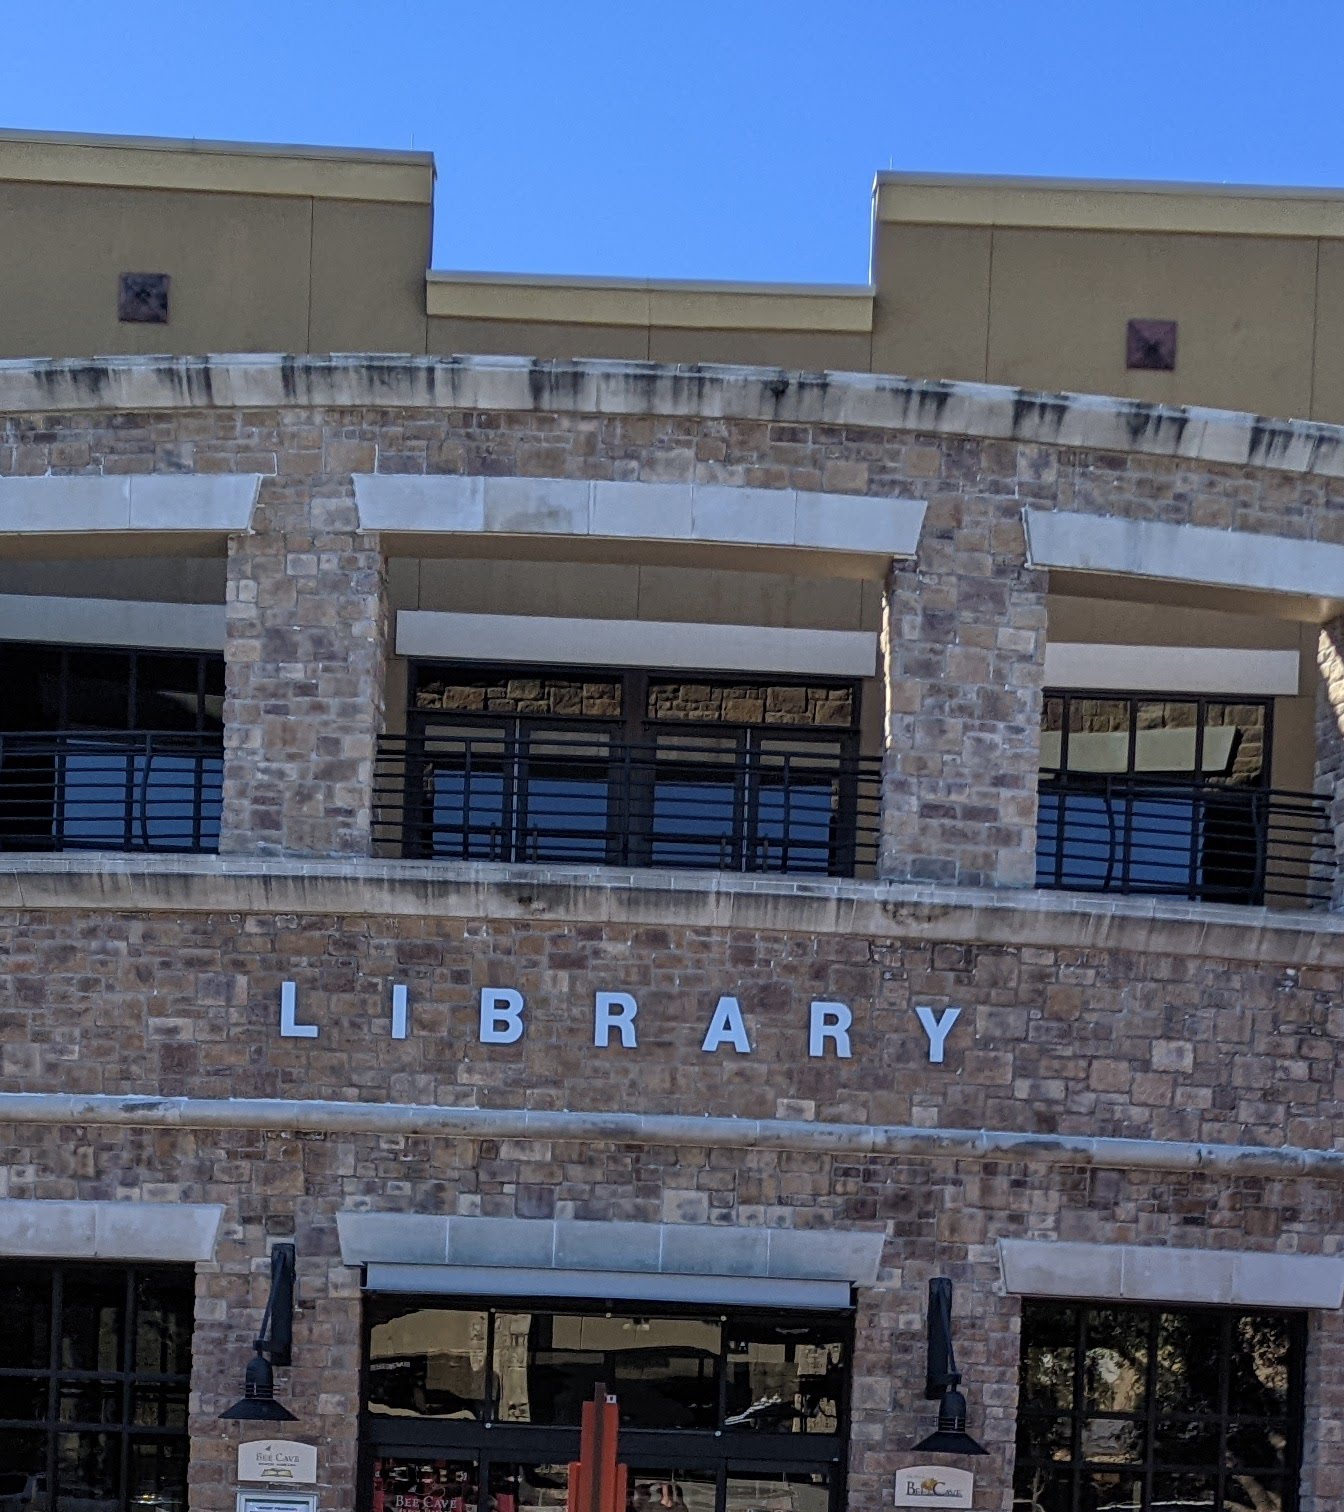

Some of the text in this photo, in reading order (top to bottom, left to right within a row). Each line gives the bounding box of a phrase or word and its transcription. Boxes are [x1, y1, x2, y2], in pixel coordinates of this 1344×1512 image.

[278, 980, 962, 1064] LIBRARY
[396, 1495, 456, 1509] BEE CAVE
